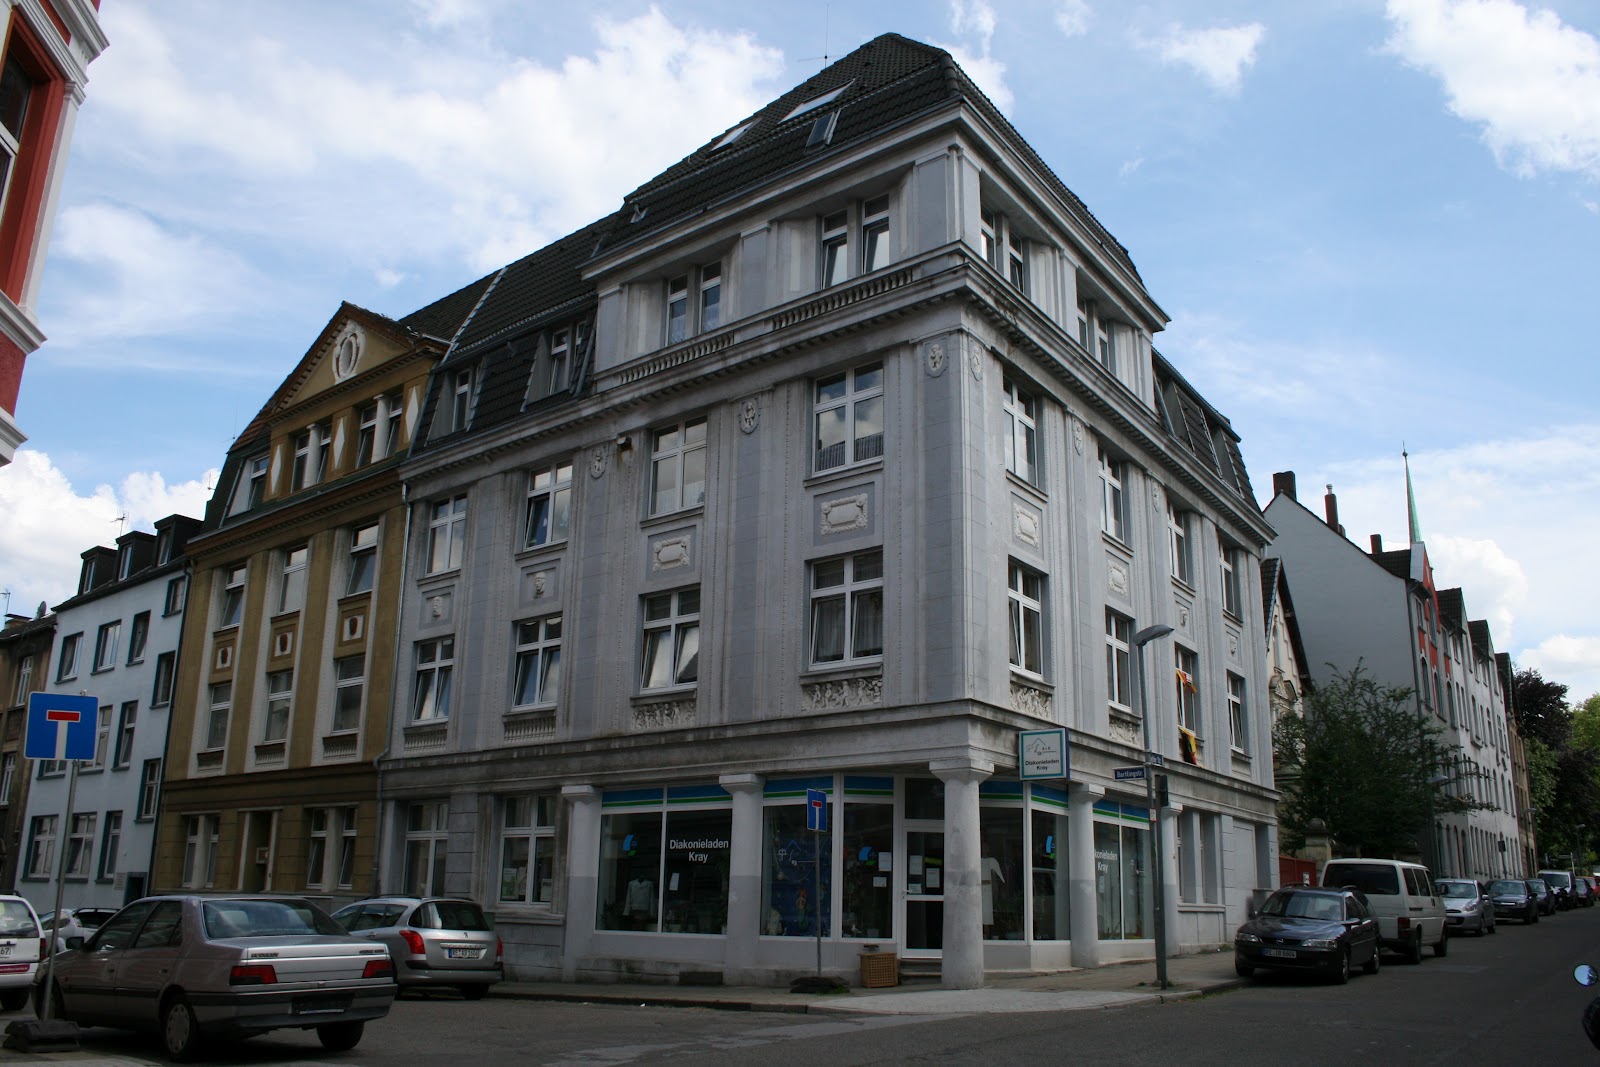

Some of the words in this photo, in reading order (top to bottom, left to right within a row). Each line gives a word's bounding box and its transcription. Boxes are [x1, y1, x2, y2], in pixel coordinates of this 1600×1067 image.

[669, 839, 728, 849] Diakonieladen
[688, 852, 708, 863] Kray
[1094, 849, 1117, 860] konieladen
[1097, 861, 1108, 873] Kray
